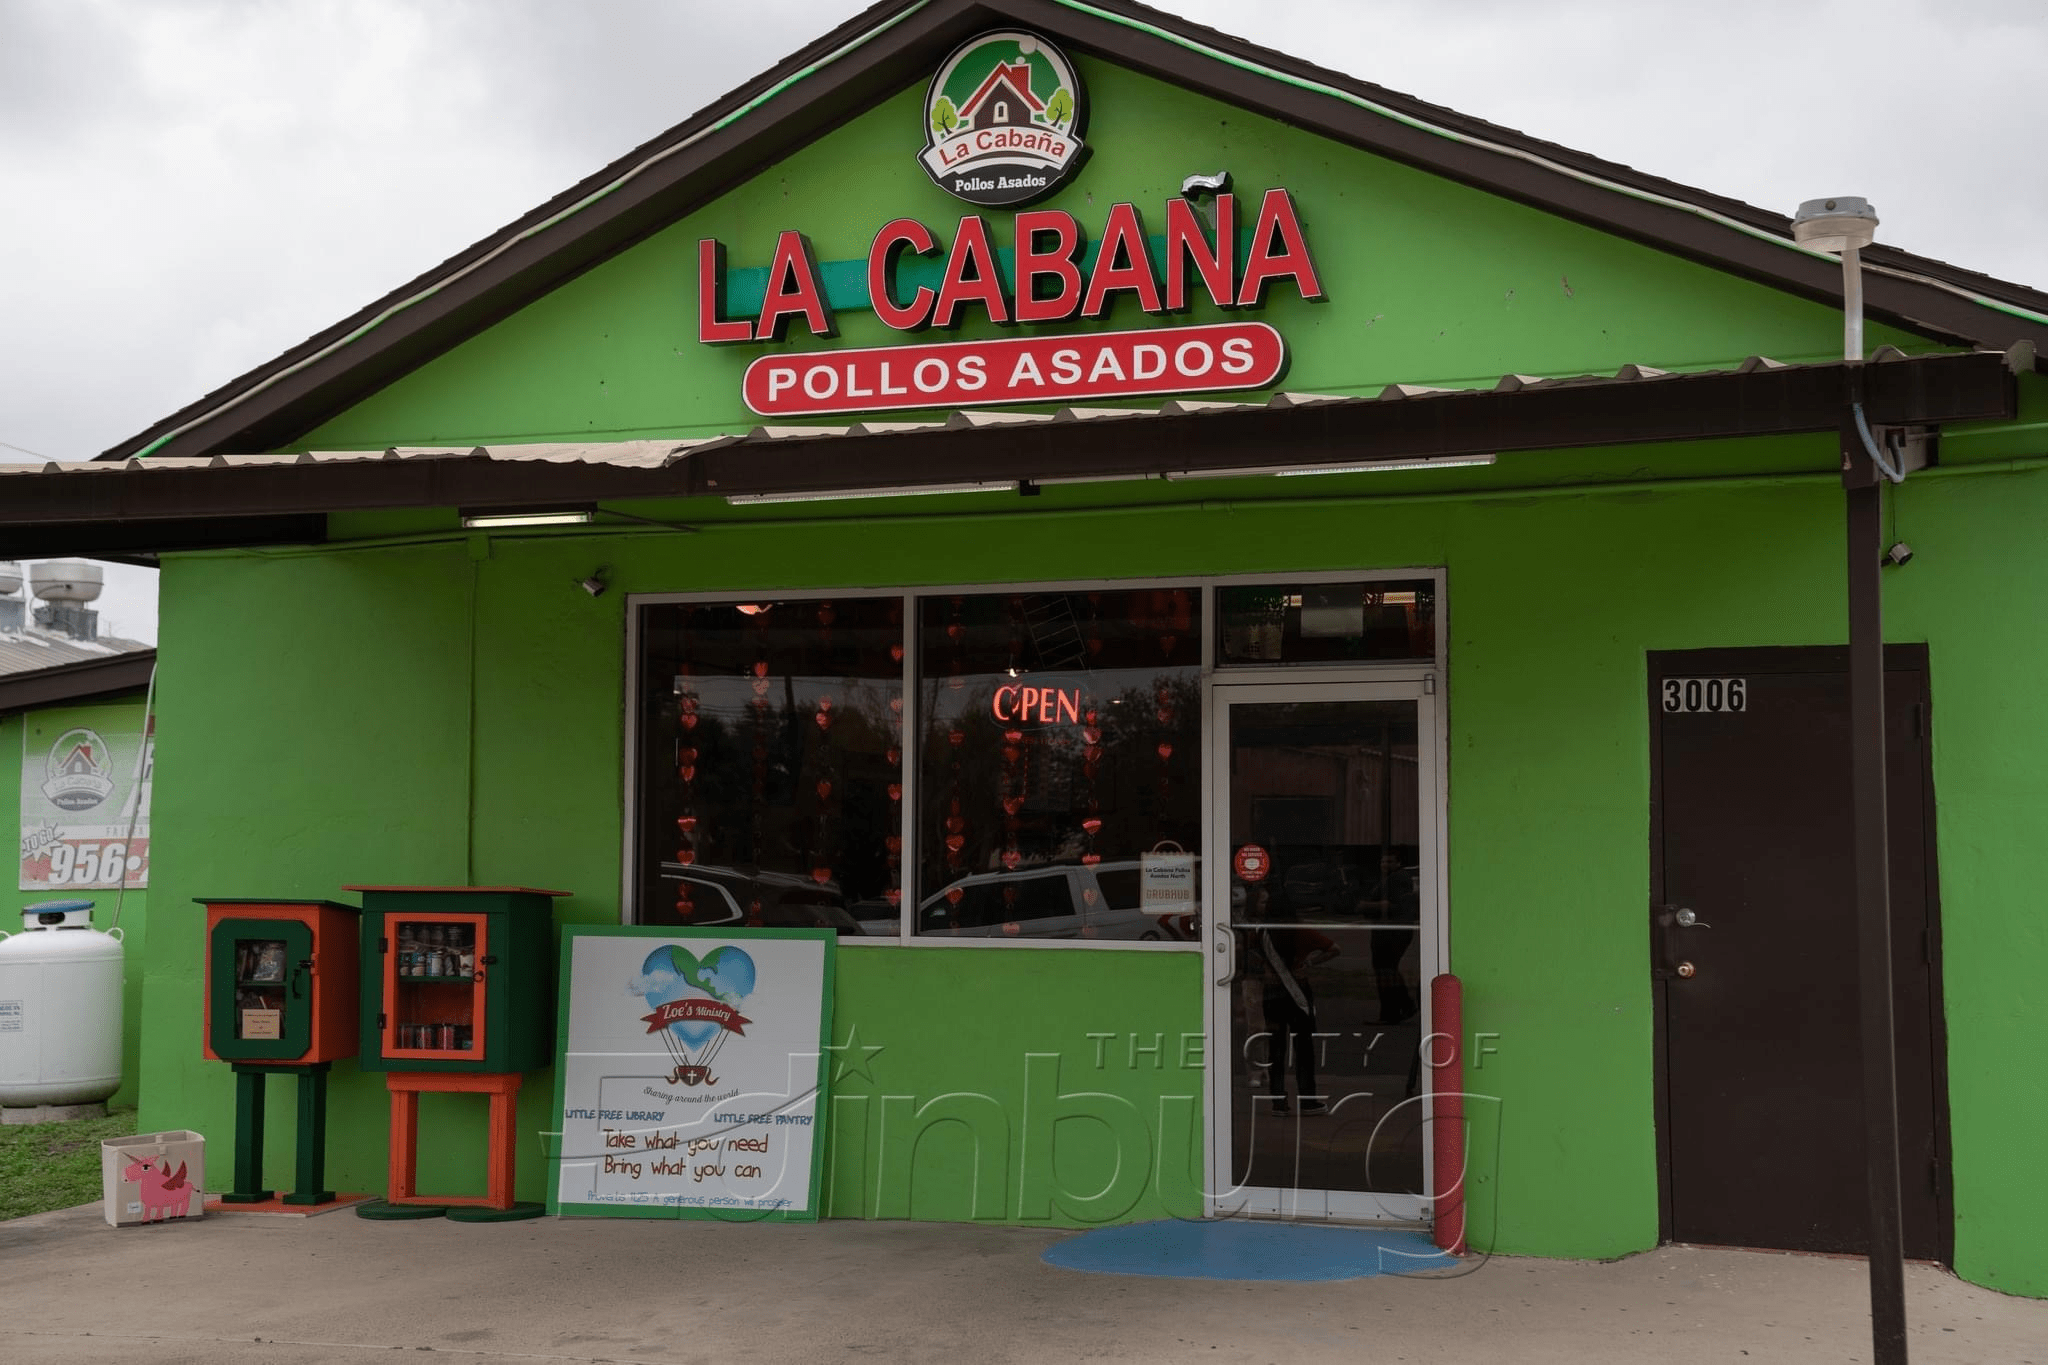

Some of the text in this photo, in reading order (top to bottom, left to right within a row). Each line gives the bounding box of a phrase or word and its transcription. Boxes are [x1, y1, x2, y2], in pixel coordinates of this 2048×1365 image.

[939, 128, 1066, 165] La Cabaña
[955, 174, 1046, 192] Pollos Asados
[698, 171, 1327, 345] LA CABAÑA
[767, 336, 1256, 402] POLLOS ASADOS
[992, 685, 1080, 724] OPEN
[1664, 679, 1744, 711] 3006
[662, 1003, 731, 1021] Zoe's Ministry
[704, 1093, 716, 1102] the
[565, 1109, 665, 1121] LITTLE FREE LIBRARY
[714, 1112, 813, 1126] LITTLE FREE PANTRY
[603, 1129, 768, 1157] Take what you need
[604, 1154, 761, 1182] Bring what you can
